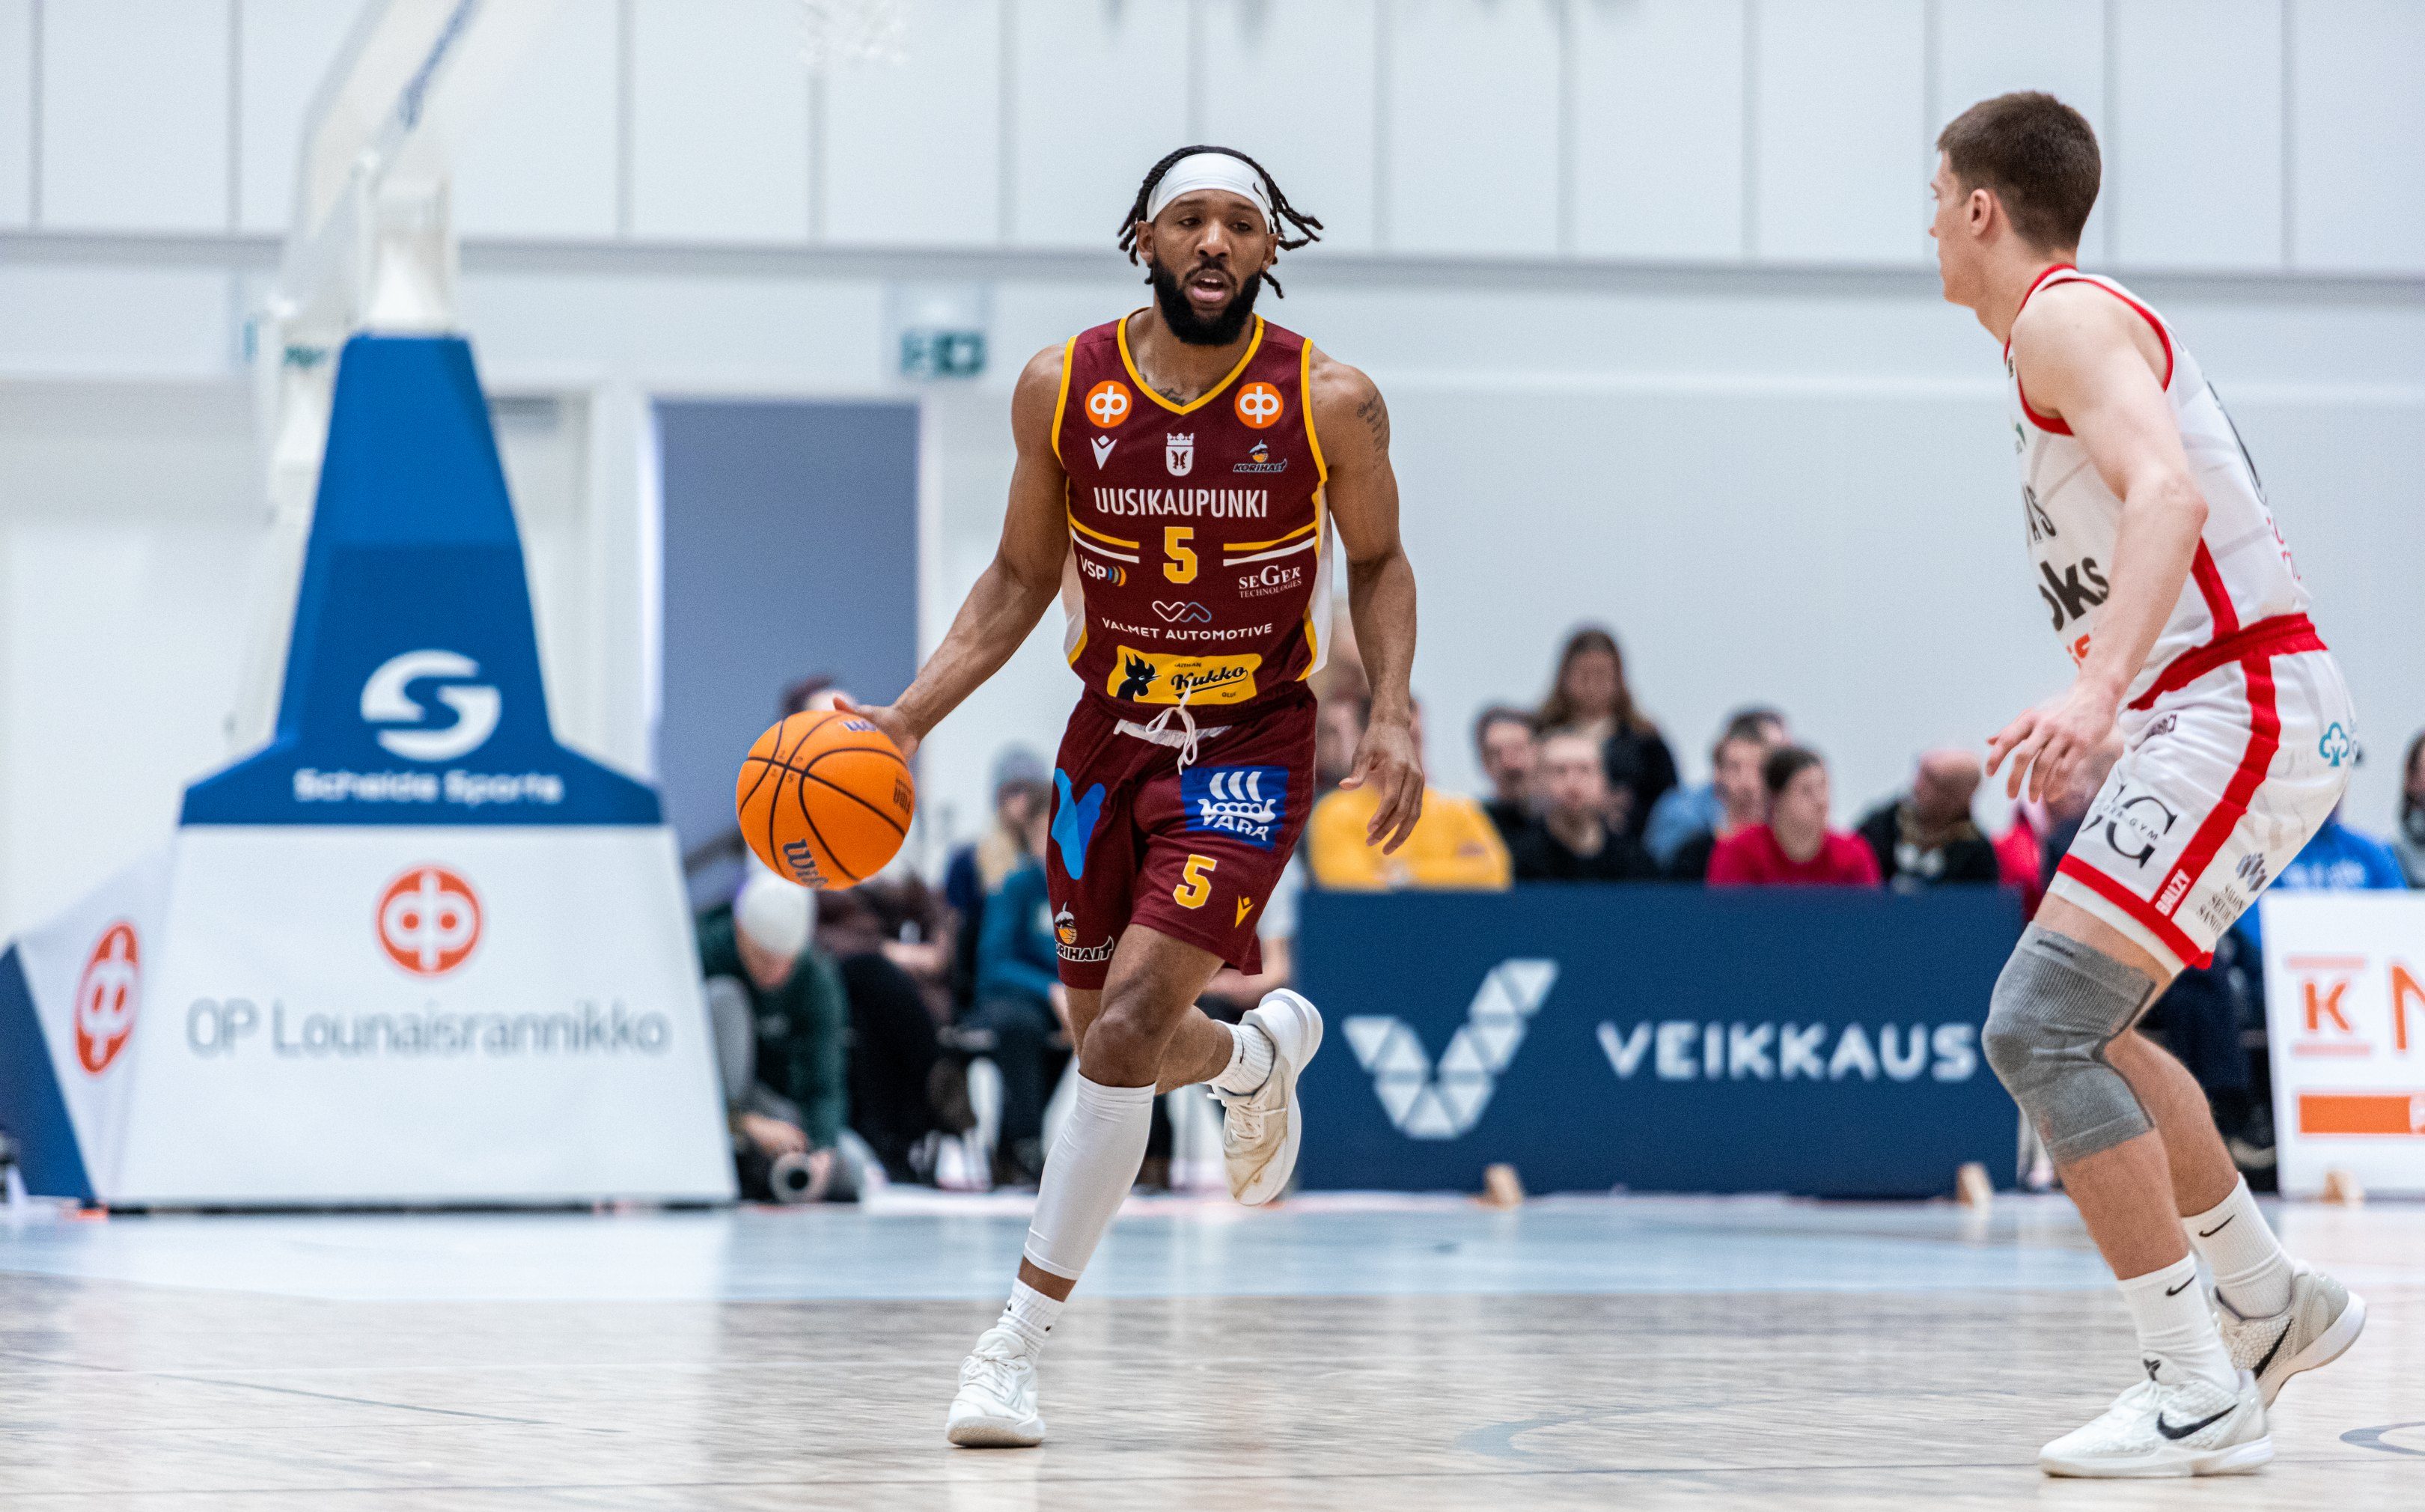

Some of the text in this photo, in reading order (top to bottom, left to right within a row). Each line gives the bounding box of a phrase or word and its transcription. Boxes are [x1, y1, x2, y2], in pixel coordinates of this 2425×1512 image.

[1093, 487, 1268, 519] UUSIKAUPUNKI
[1080, 554, 1106, 580] VSP
[1163, 526, 1198, 584] 5
[1239, 579, 1302, 598] TECHNOLOGIES
[1102, 616, 1272, 640] VALMET AUTOMOTIVE
[1171, 666, 1248, 690] Kukko
[445, 769, 563, 808] Sports
[1202, 814, 1270, 841] YARA
[1173, 853, 1218, 910] 5
[186, 996, 674, 1058] OP Lounaisrannikko
[1596, 1021, 1979, 1082] VEIKKAUS
